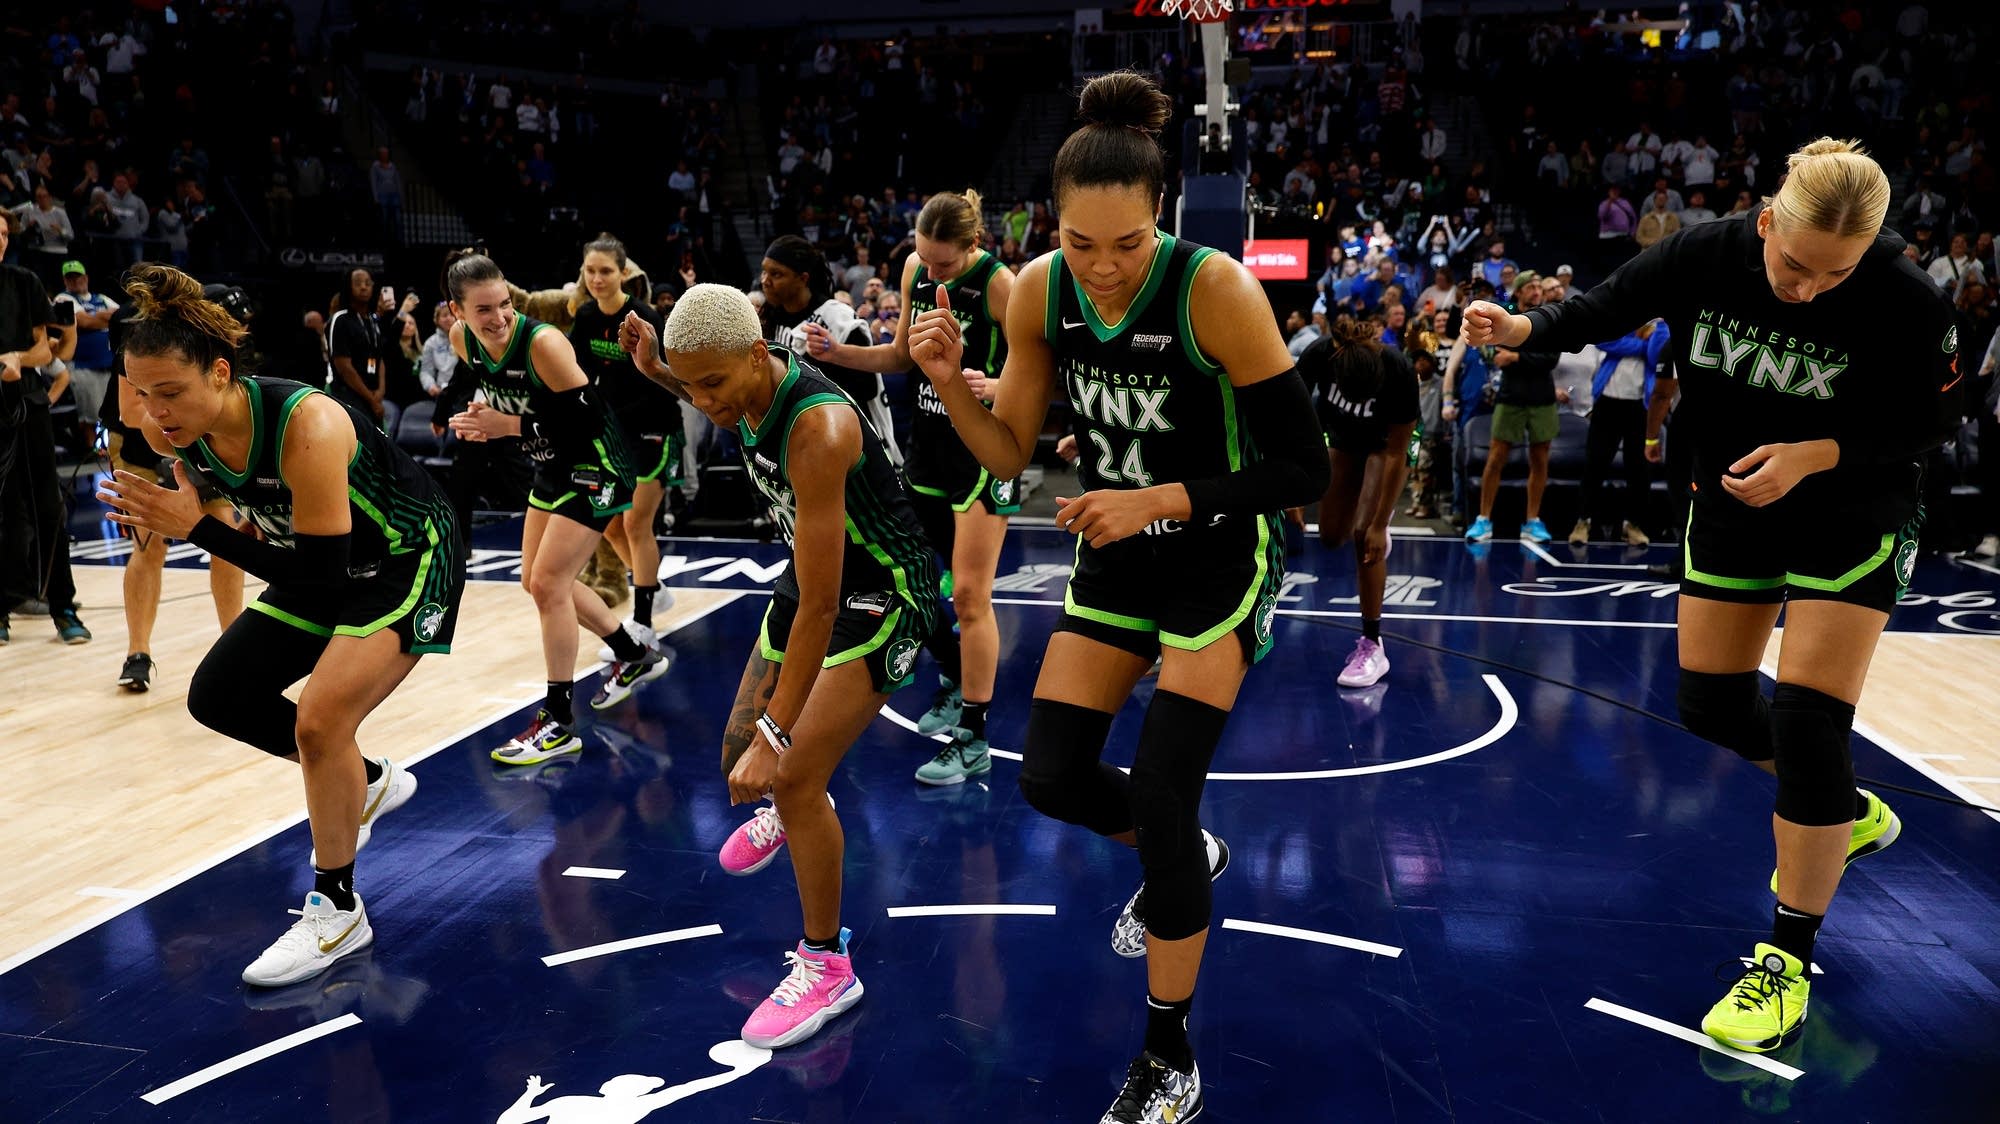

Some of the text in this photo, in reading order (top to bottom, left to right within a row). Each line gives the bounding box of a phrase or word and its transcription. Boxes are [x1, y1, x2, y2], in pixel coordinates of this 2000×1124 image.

[308, 252, 384, 265] LEXUS
[1132, 333, 1172, 344] FEDERATED
[1689, 321, 1849, 400] LYNX
[1698, 308, 1849, 363] MINNESOTA
[1088, 429, 1154, 488] 24
